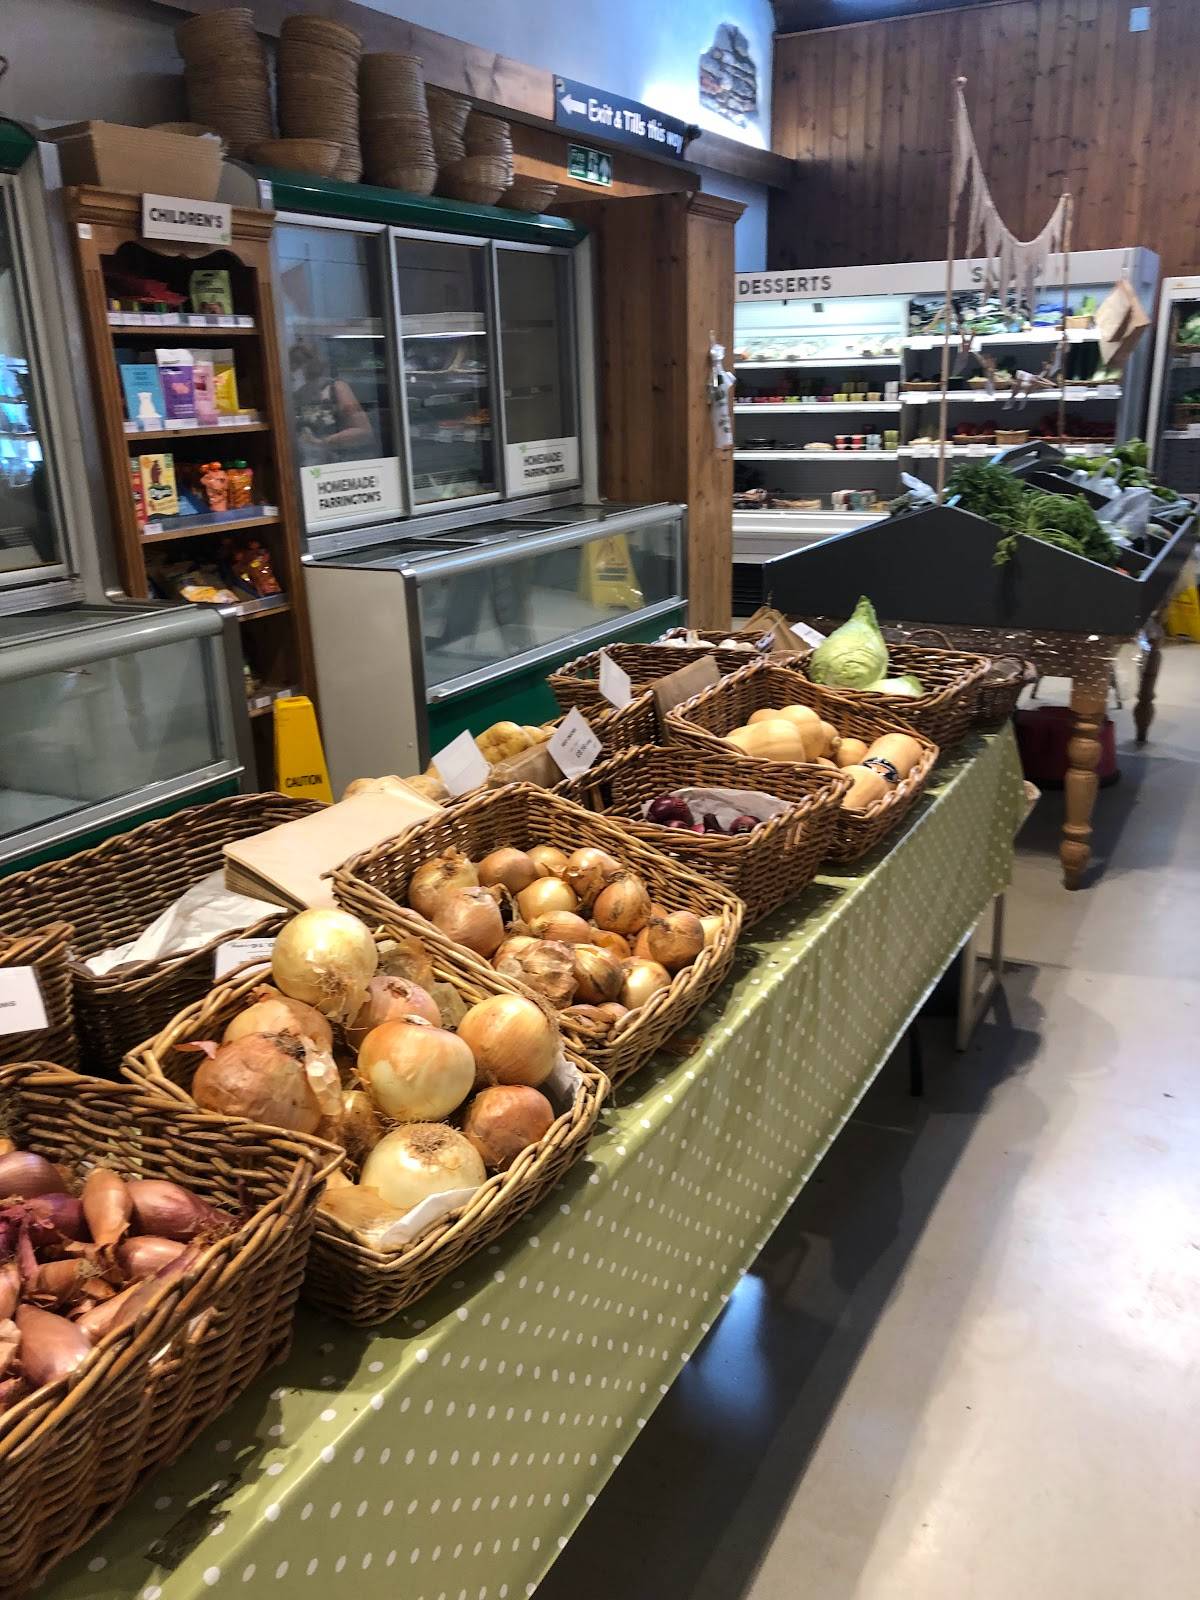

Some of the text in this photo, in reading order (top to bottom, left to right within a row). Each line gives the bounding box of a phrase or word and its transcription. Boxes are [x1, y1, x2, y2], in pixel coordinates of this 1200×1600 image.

[588, 98, 684, 154] Exit & Tills this way
[149, 207, 224, 229] CHILDREN'S
[738, 275, 832, 296] DESSERTS
[523, 451, 563, 467] HOMEMADE
[317, 475, 376, 495] HOMEMADE
[285, 774, 323, 788] CAUTION
